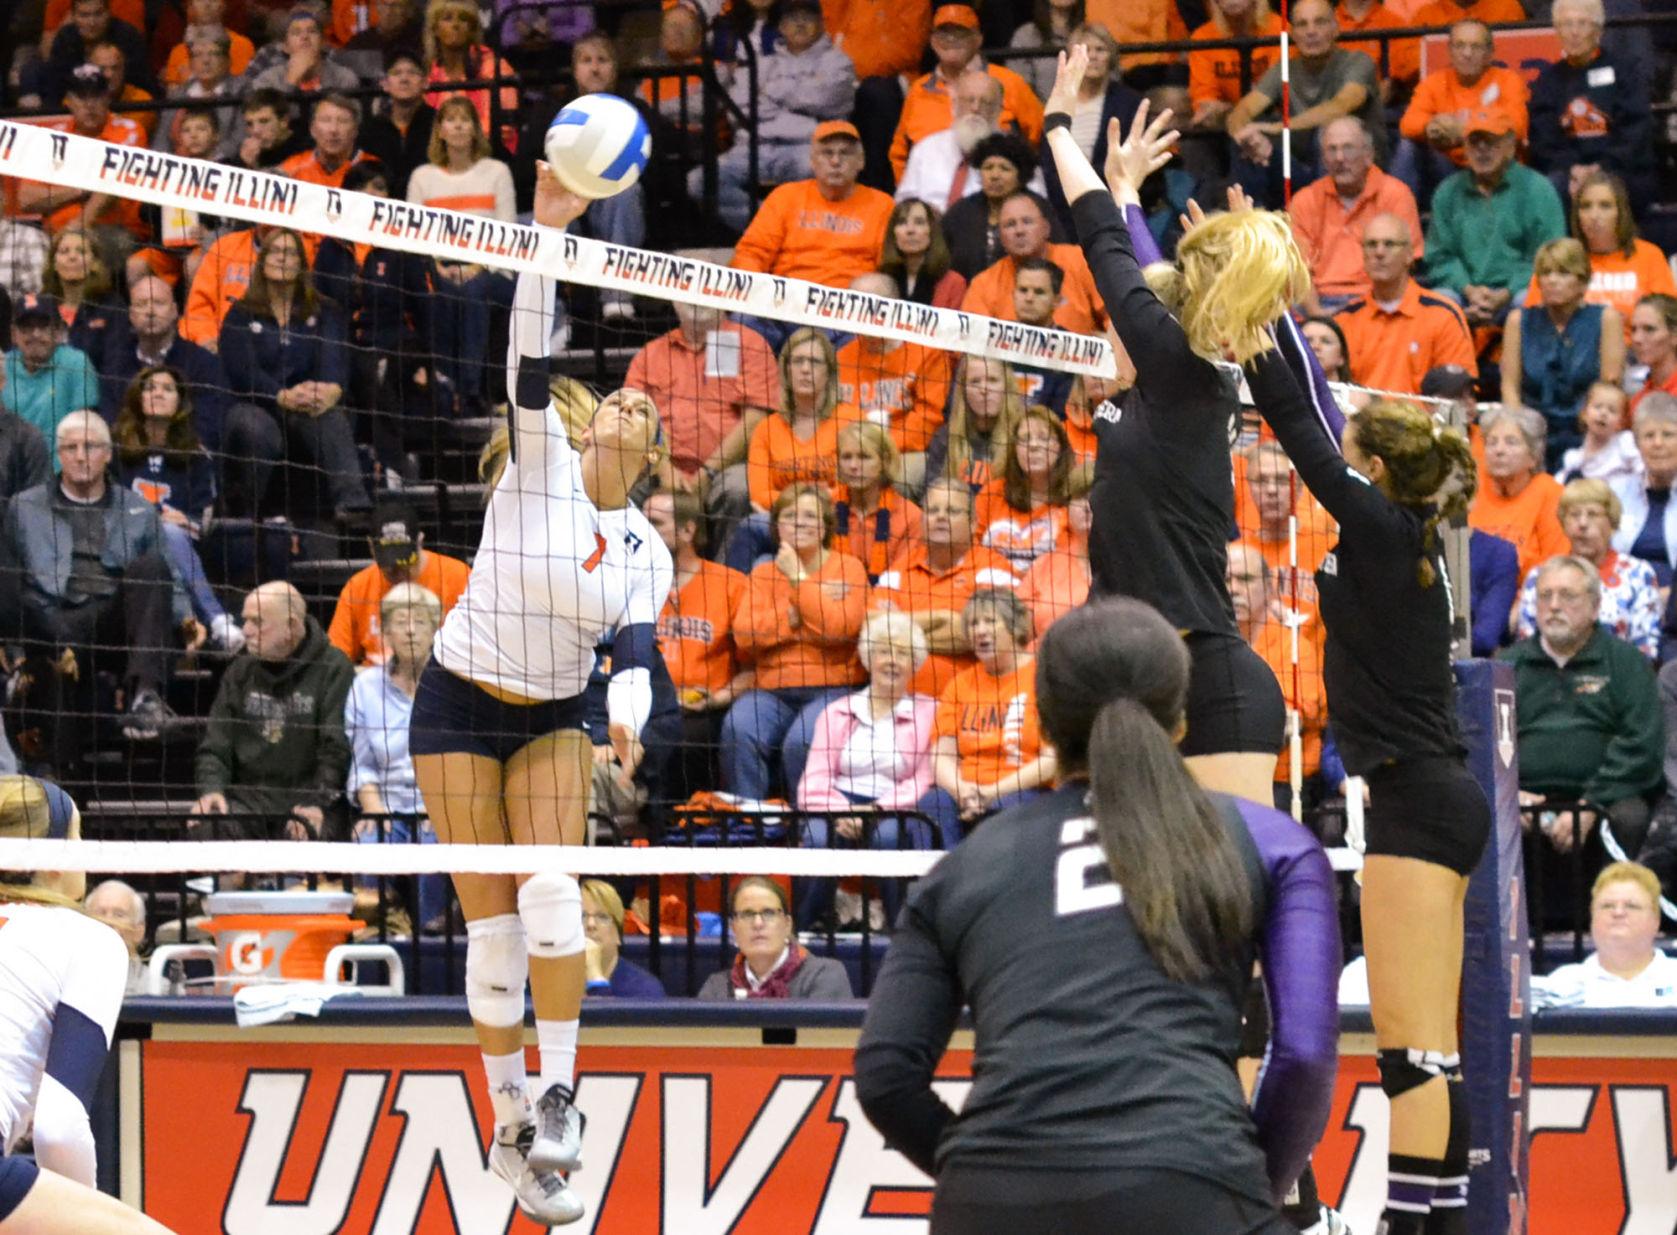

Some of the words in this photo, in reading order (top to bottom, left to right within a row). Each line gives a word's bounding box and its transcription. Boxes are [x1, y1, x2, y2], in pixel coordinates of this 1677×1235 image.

[100, 146, 222, 201] FIGHTING
[224, 171, 298, 215] ILLINI
[368, 201, 474, 248] FIGHTING
[475, 219, 540, 260] ILLINI
[602, 247, 696, 291] FIGHTING
[697, 264, 753, 302] ILLINI
[805, 287, 889, 326] FIGHTING
[889, 301, 939, 336] ILLINI
[987, 320, 1061, 362] FIGHTING
[1060, 336, 1105, 367] ILLINI
[231, 931, 262, 975] G
